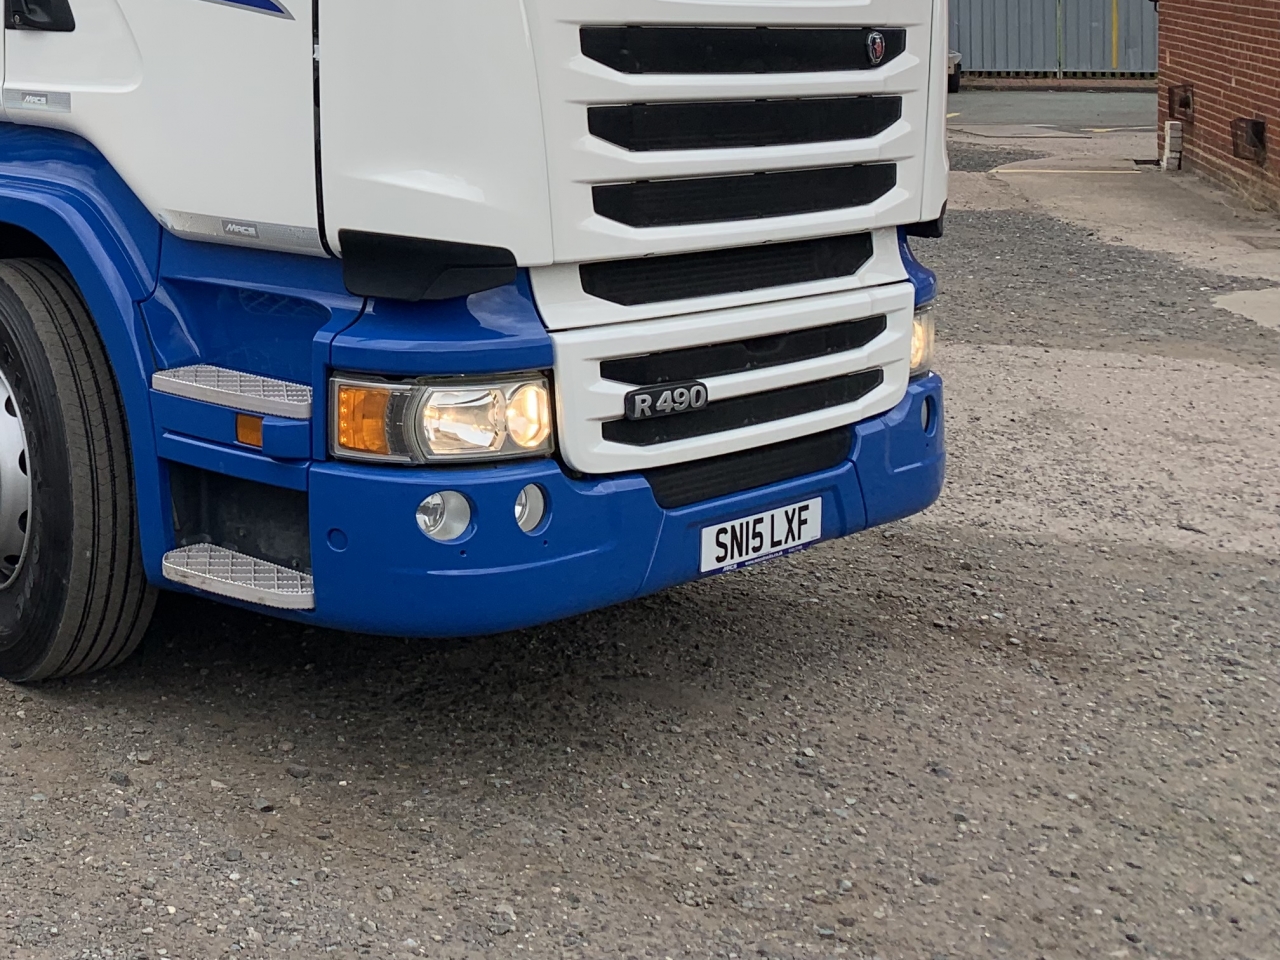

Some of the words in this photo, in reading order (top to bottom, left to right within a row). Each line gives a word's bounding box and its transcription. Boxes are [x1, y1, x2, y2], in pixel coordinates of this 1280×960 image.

[225, 223, 256, 235] MACS
[634, 394, 652, 418] R
[655, 385, 707, 413] 490
[715, 516, 764, 563] SN15
[770, 504, 810, 549] LXF
